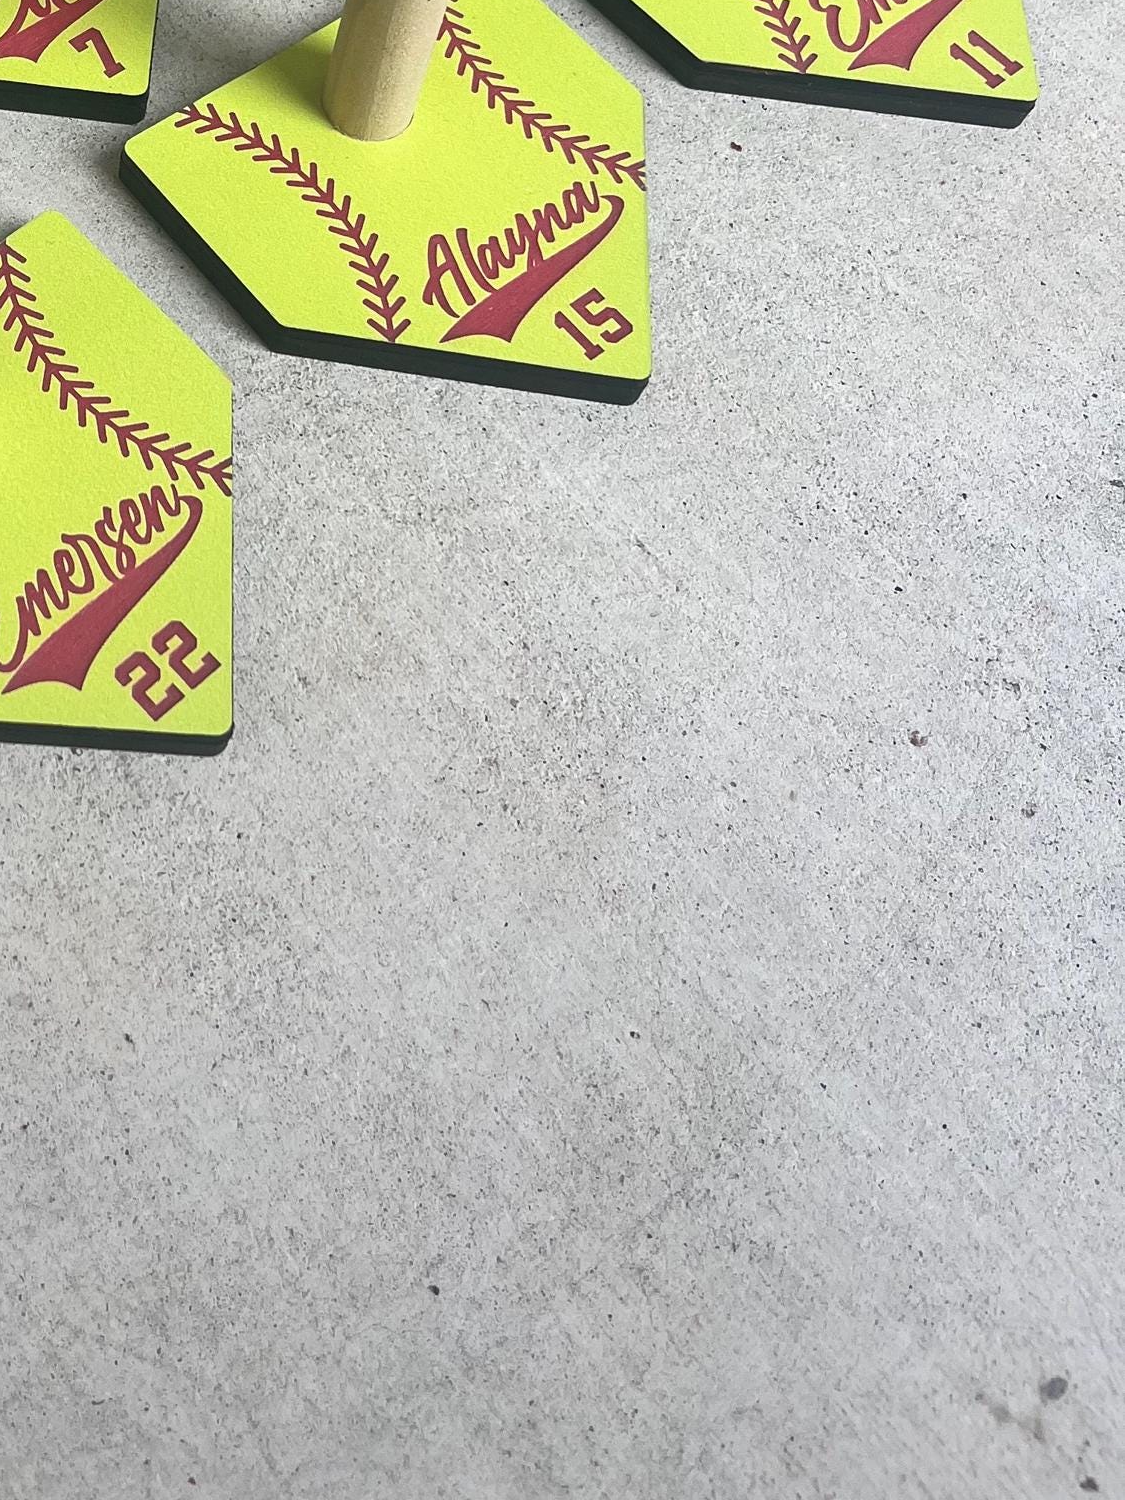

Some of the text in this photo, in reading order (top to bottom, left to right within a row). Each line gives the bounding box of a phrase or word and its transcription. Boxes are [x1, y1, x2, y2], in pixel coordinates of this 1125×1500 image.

[68, 27, 126, 79] 7
[949, 30, 1024, 89] 11
[422, 181, 601, 318] Alayna
[554, 287, 634, 361] 15
[114, 620, 222, 722] 22
